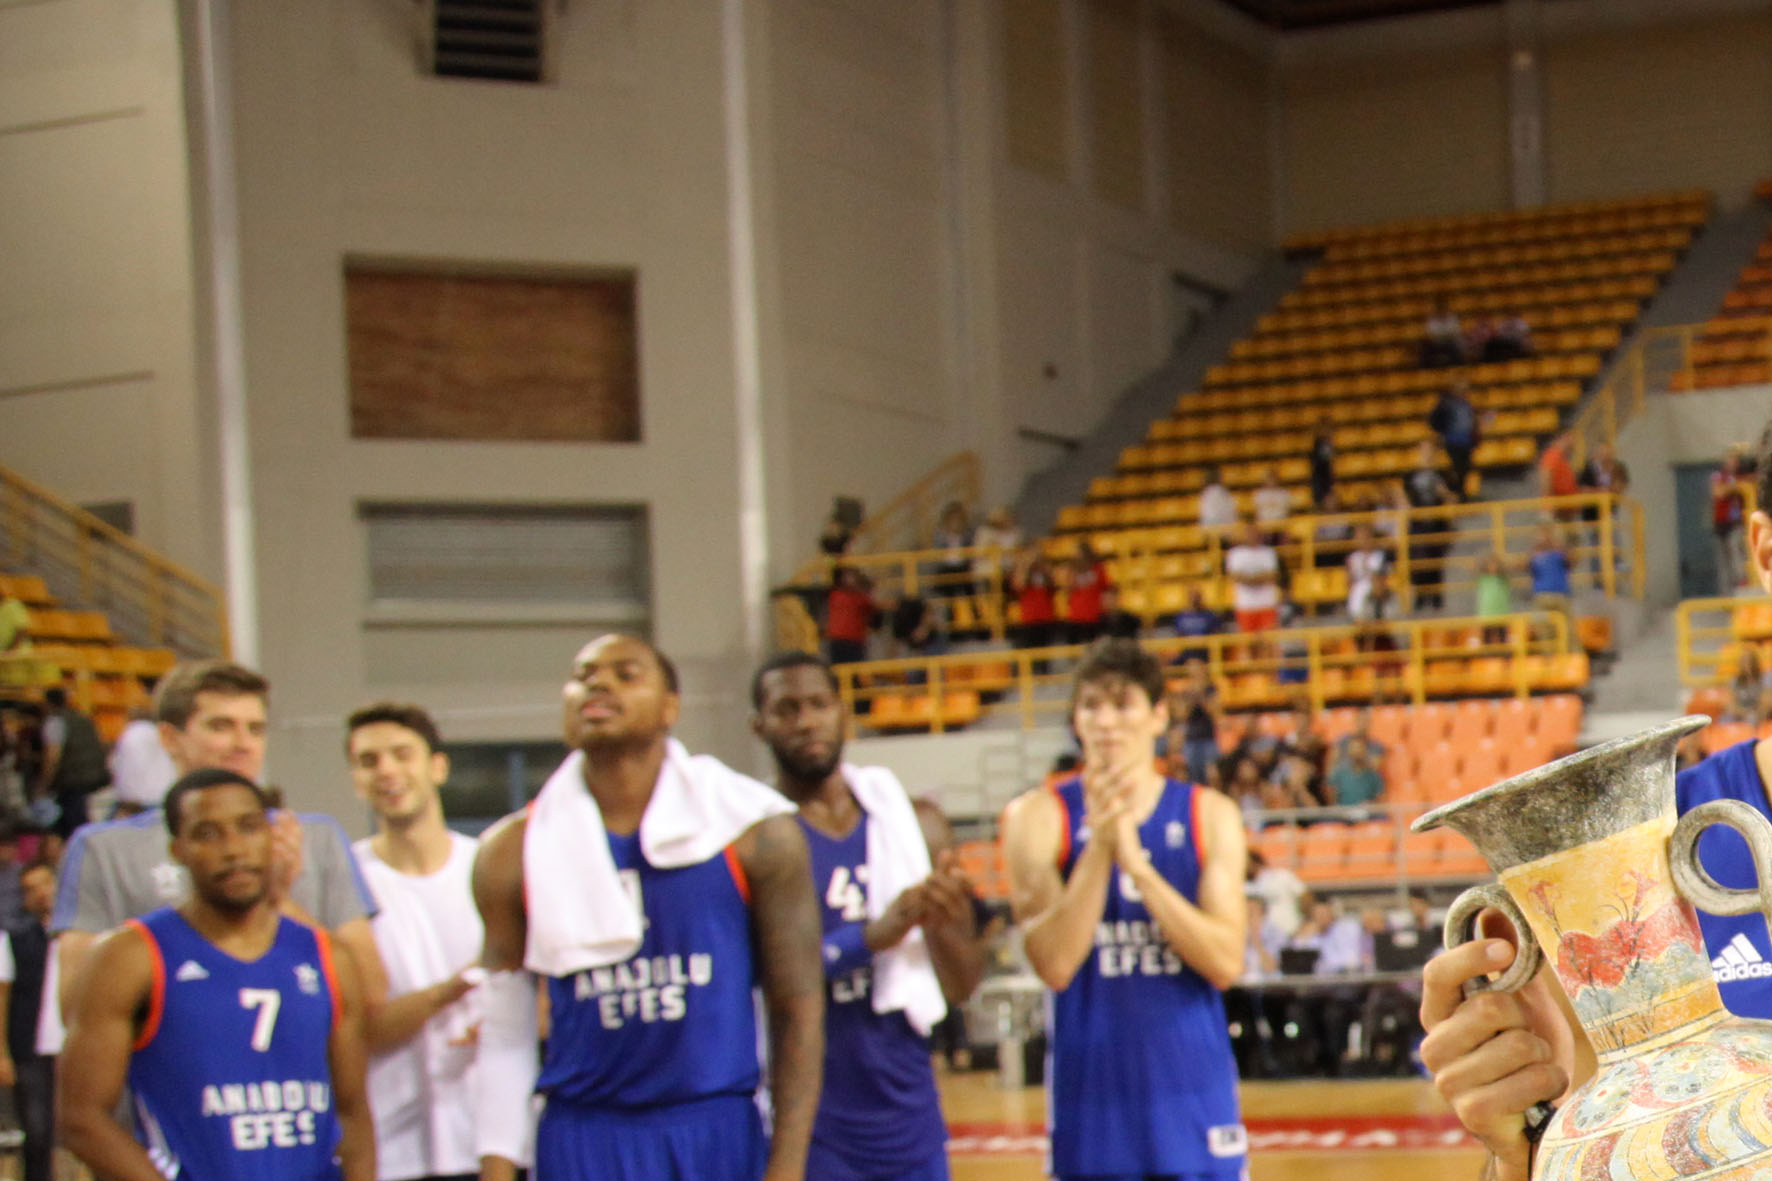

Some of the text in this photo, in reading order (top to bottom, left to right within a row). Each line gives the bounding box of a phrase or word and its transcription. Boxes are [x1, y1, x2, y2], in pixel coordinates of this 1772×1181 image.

[826, 866, 868, 921] 4
[238, 987, 282, 1053] 7
[600, 985, 687, 1029] EFES
[201, 1080, 330, 1117] ANADOU
[230, 1109, 317, 1150] EFES
